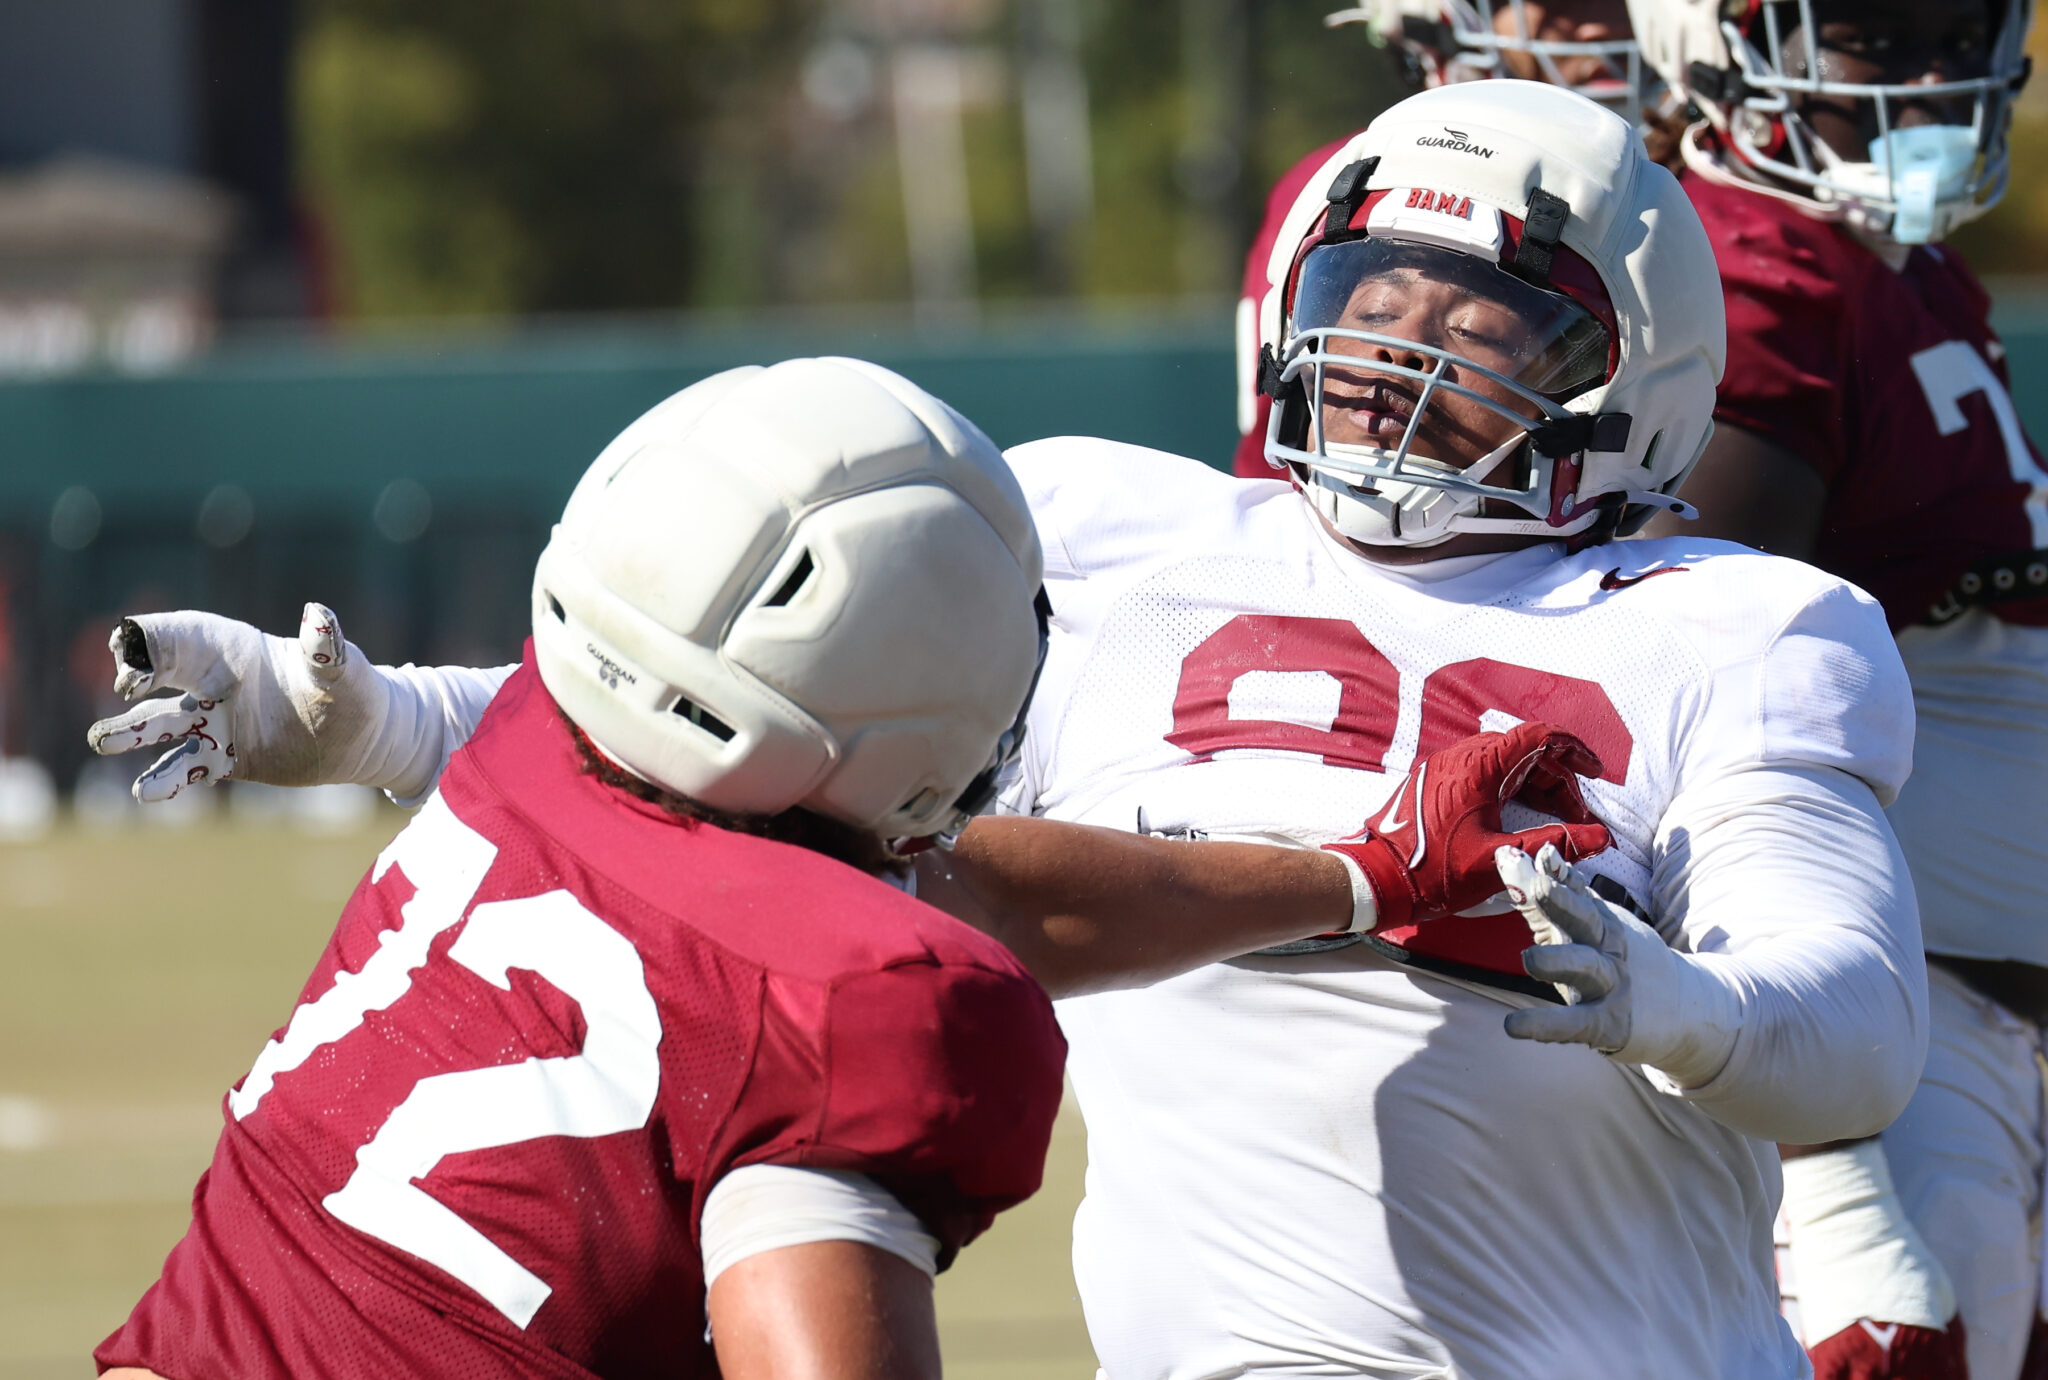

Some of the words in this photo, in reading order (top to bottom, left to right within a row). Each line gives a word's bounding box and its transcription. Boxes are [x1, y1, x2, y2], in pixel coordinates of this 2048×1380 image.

[1416, 136, 1494, 159] GUARDIAN
[1405, 187, 1472, 219] BAMA
[586, 643, 637, 685] GUARDIAN
[229, 786, 664, 1331] 72
